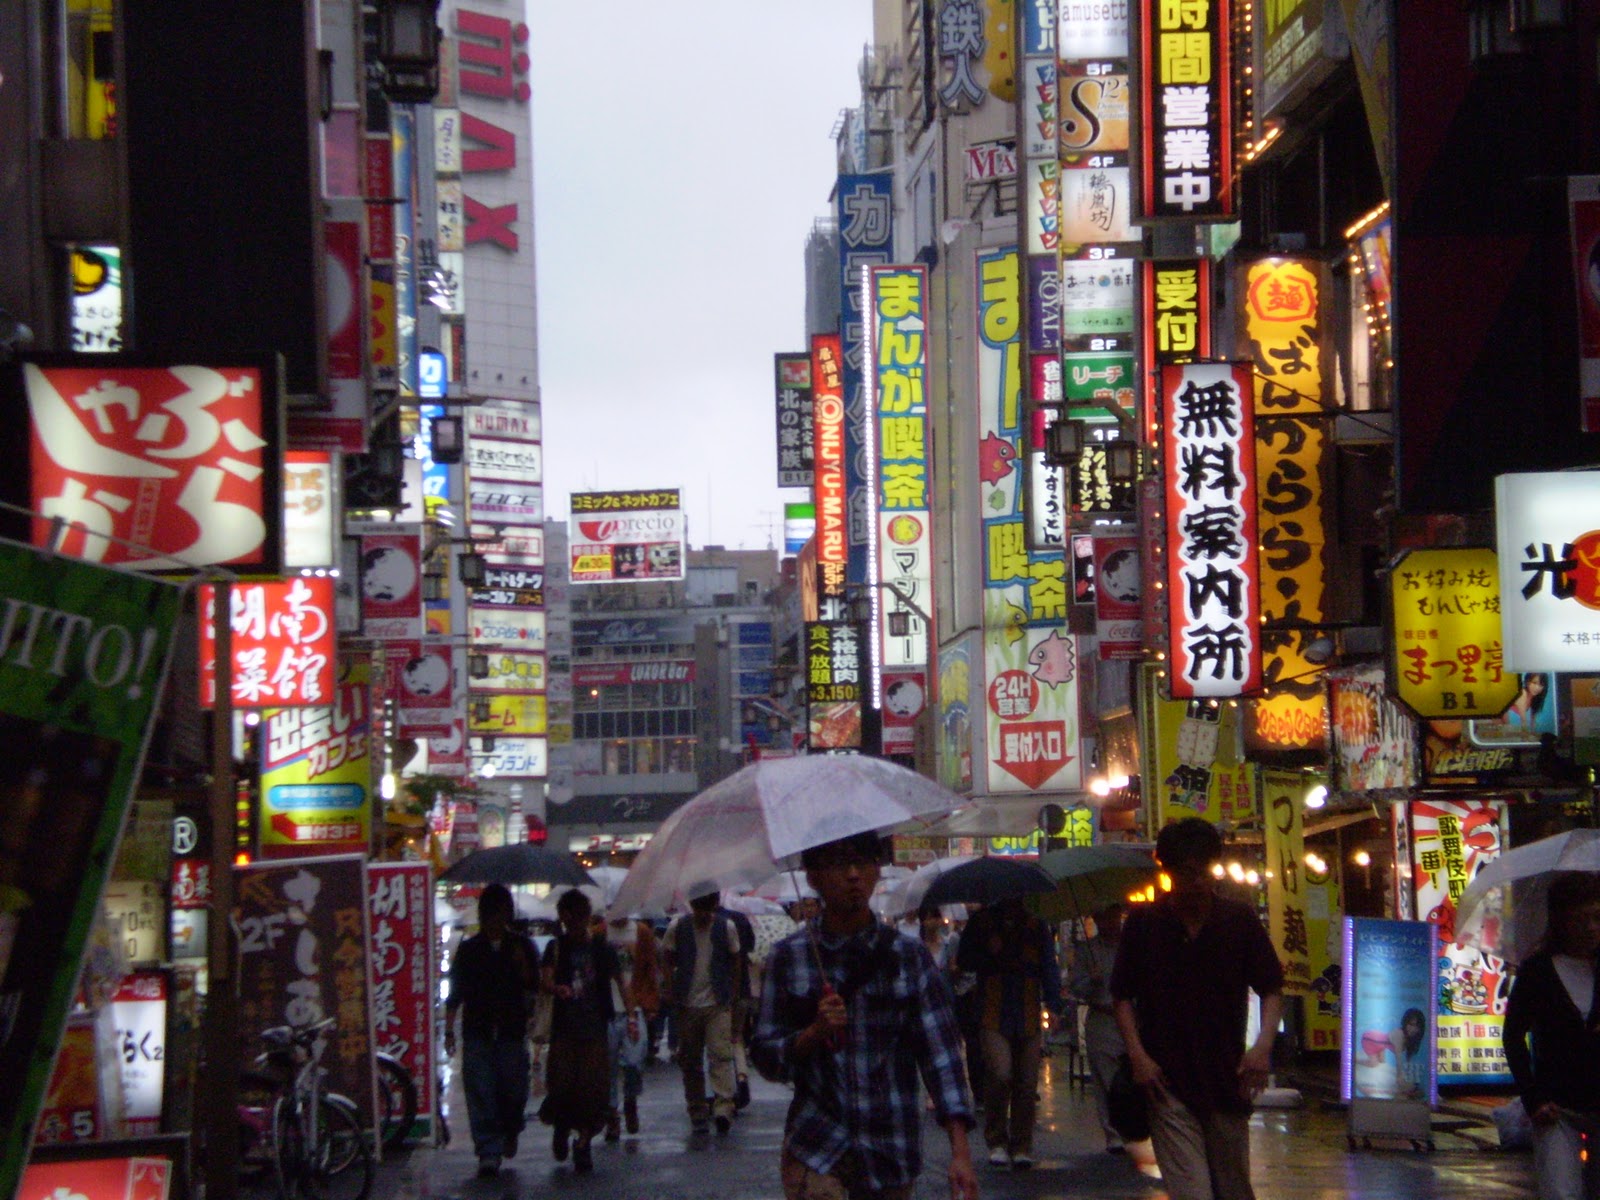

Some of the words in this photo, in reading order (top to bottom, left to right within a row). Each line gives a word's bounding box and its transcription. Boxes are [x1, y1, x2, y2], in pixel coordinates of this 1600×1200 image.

[1086, 63, 1113, 76] 5F
[1088, 156, 1115, 168] 4F
[1089, 248, 1116, 260] 3F
[1156, 270, 1197, 352] 受付
[1090, 339, 1118, 351] 2F
[1073, 366, 1123, 385] リーチ
[876, 274, 925, 508] まんが喫茶
[475, 414, 529, 433] HUMAX
[1094, 429, 1119, 441] 1F
[1179, 379, 1242, 682] 無料案内所
[809, 625, 832, 685] 食べ放題
[832, 625, 859, 684] 本格焼肉
[995, 677, 1032, 698] 24H
[998, 698, 1030, 716] 営業
[1441, 691, 1477, 710] B1
[308, 732, 367, 780] カフェ
[1005, 730, 1061, 763] 受付入口
